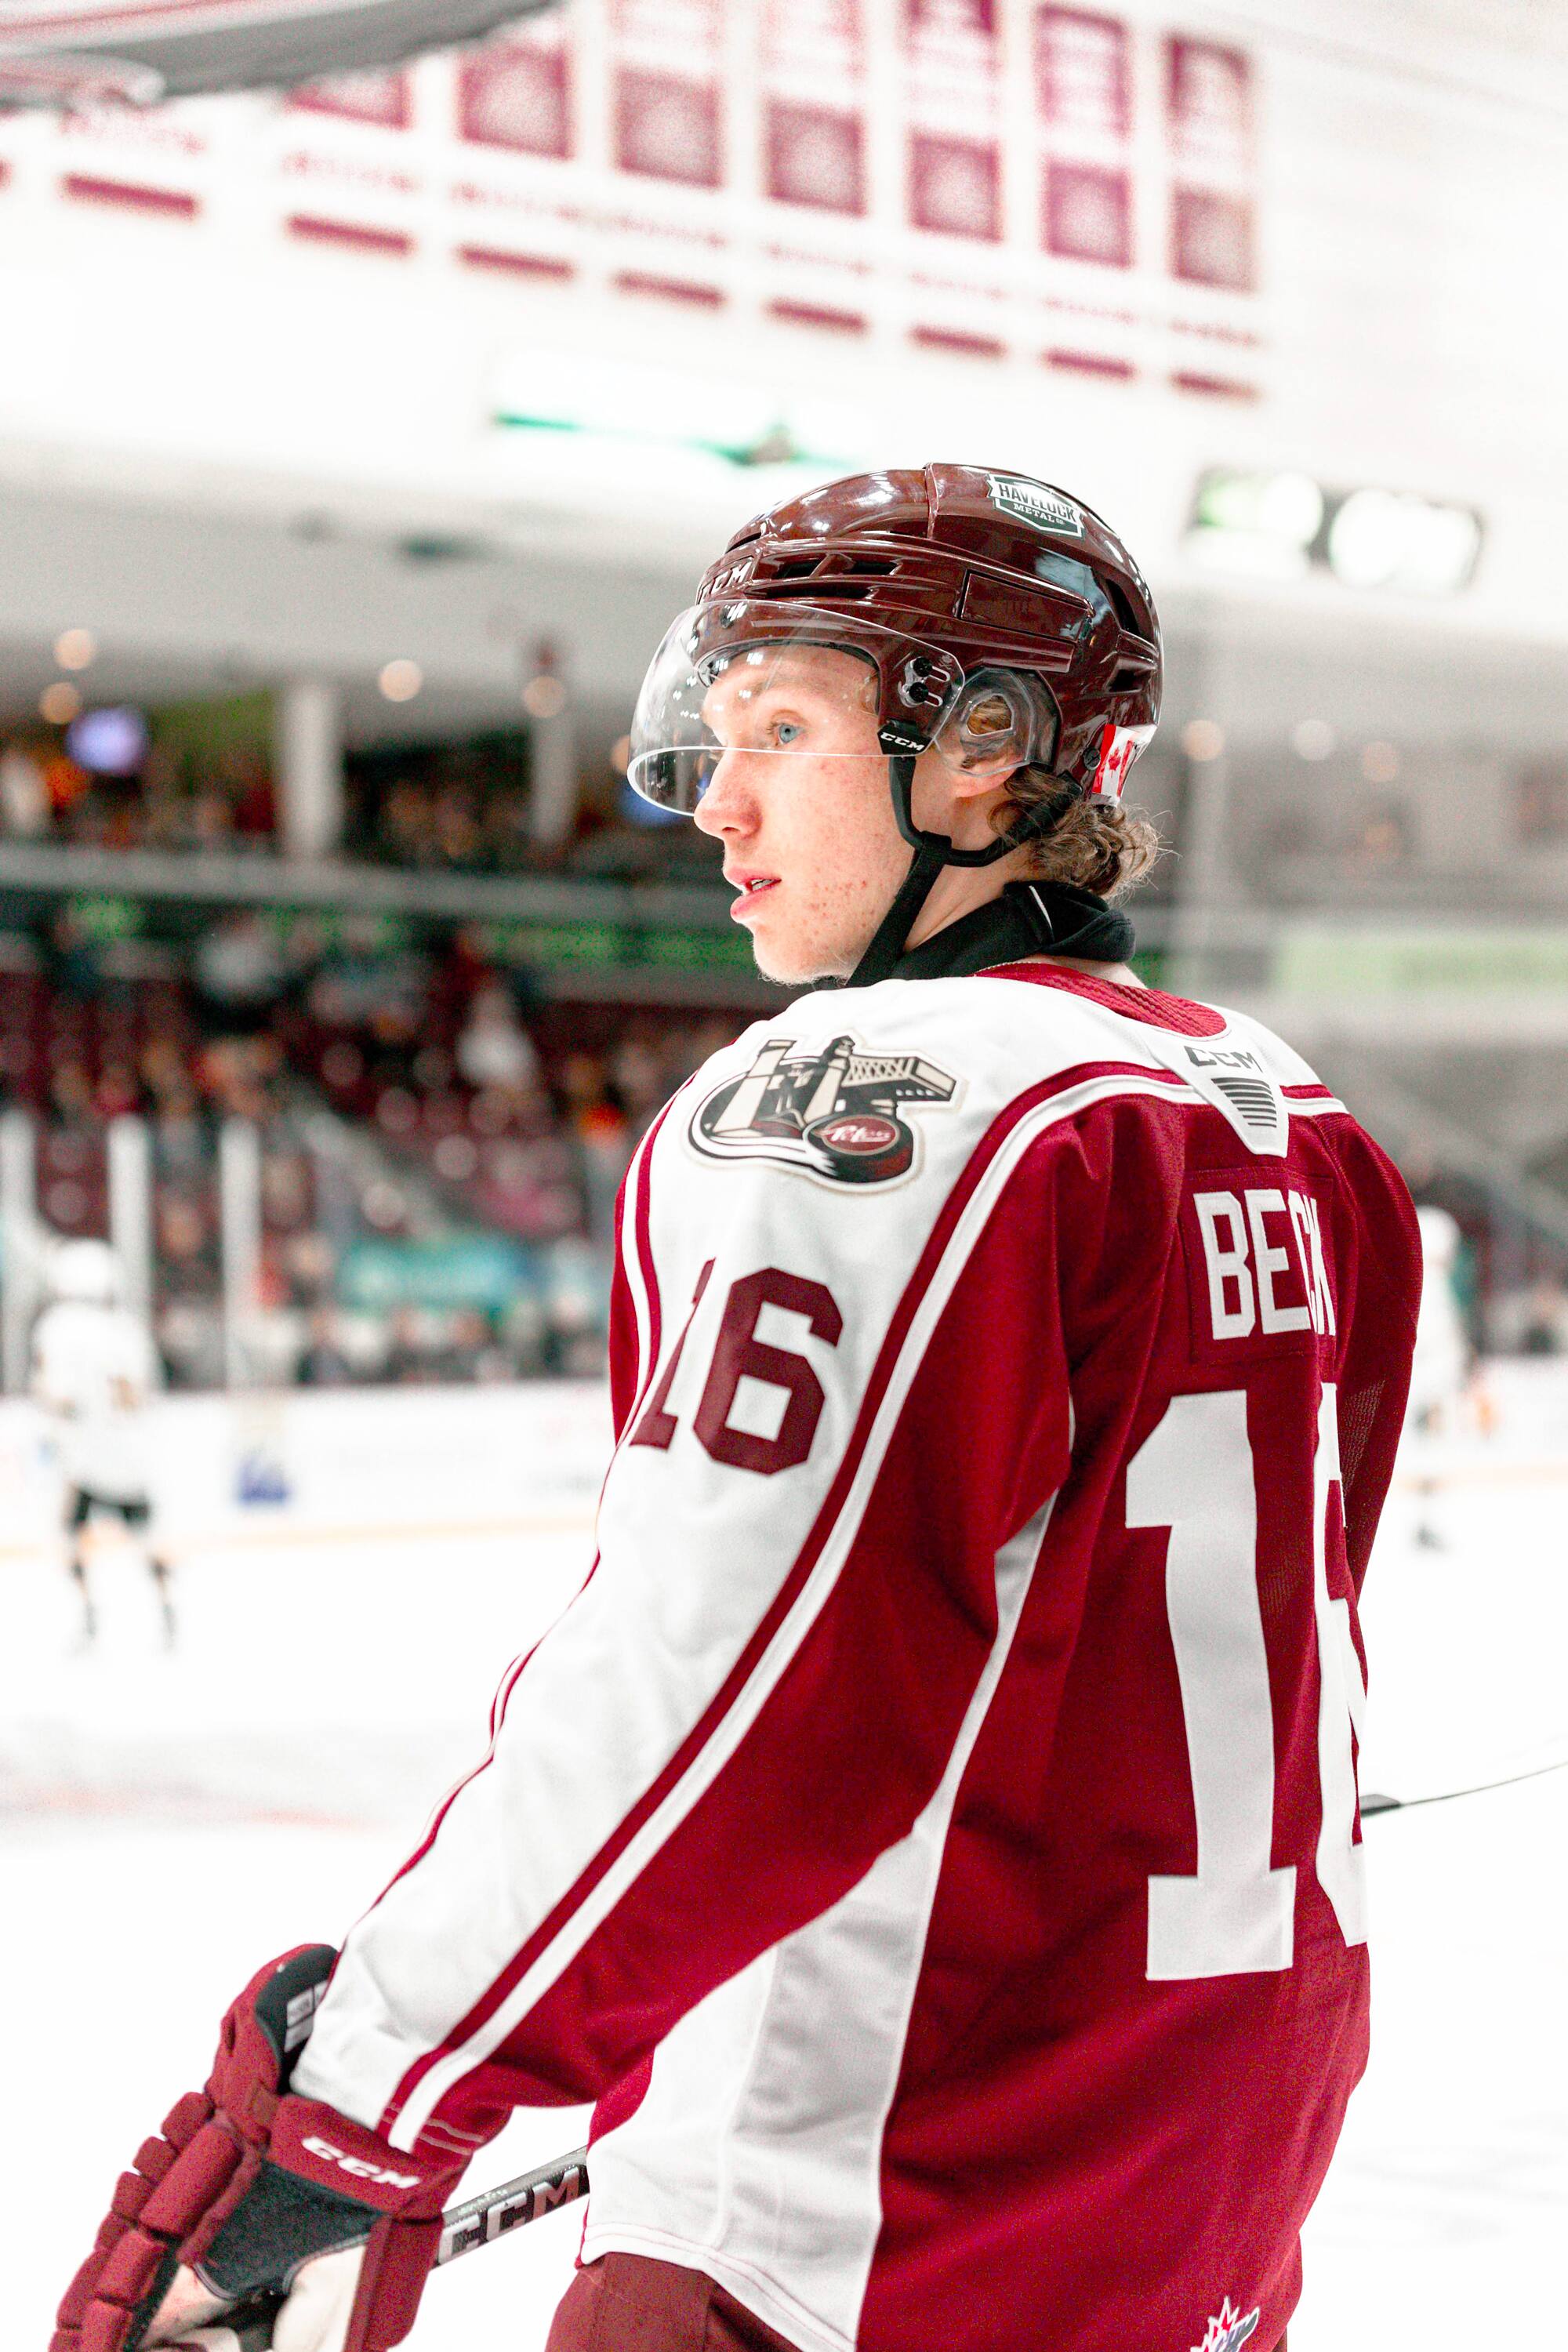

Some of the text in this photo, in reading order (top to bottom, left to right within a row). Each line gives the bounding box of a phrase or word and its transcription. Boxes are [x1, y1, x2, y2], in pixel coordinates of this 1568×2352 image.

[998, 483, 1076, 522] HAVELOCK
[1013, 503, 1055, 523] METAL
[880, 731, 925, 751] CCM
[1184, 1045, 1263, 1073] CCM
[1192, 1188, 1336, 1341] BECK
[628, 1257, 844, 1475] 16
[301, 2136, 421, 2189] CCM
[437, 2165, 580, 2266] CCM
